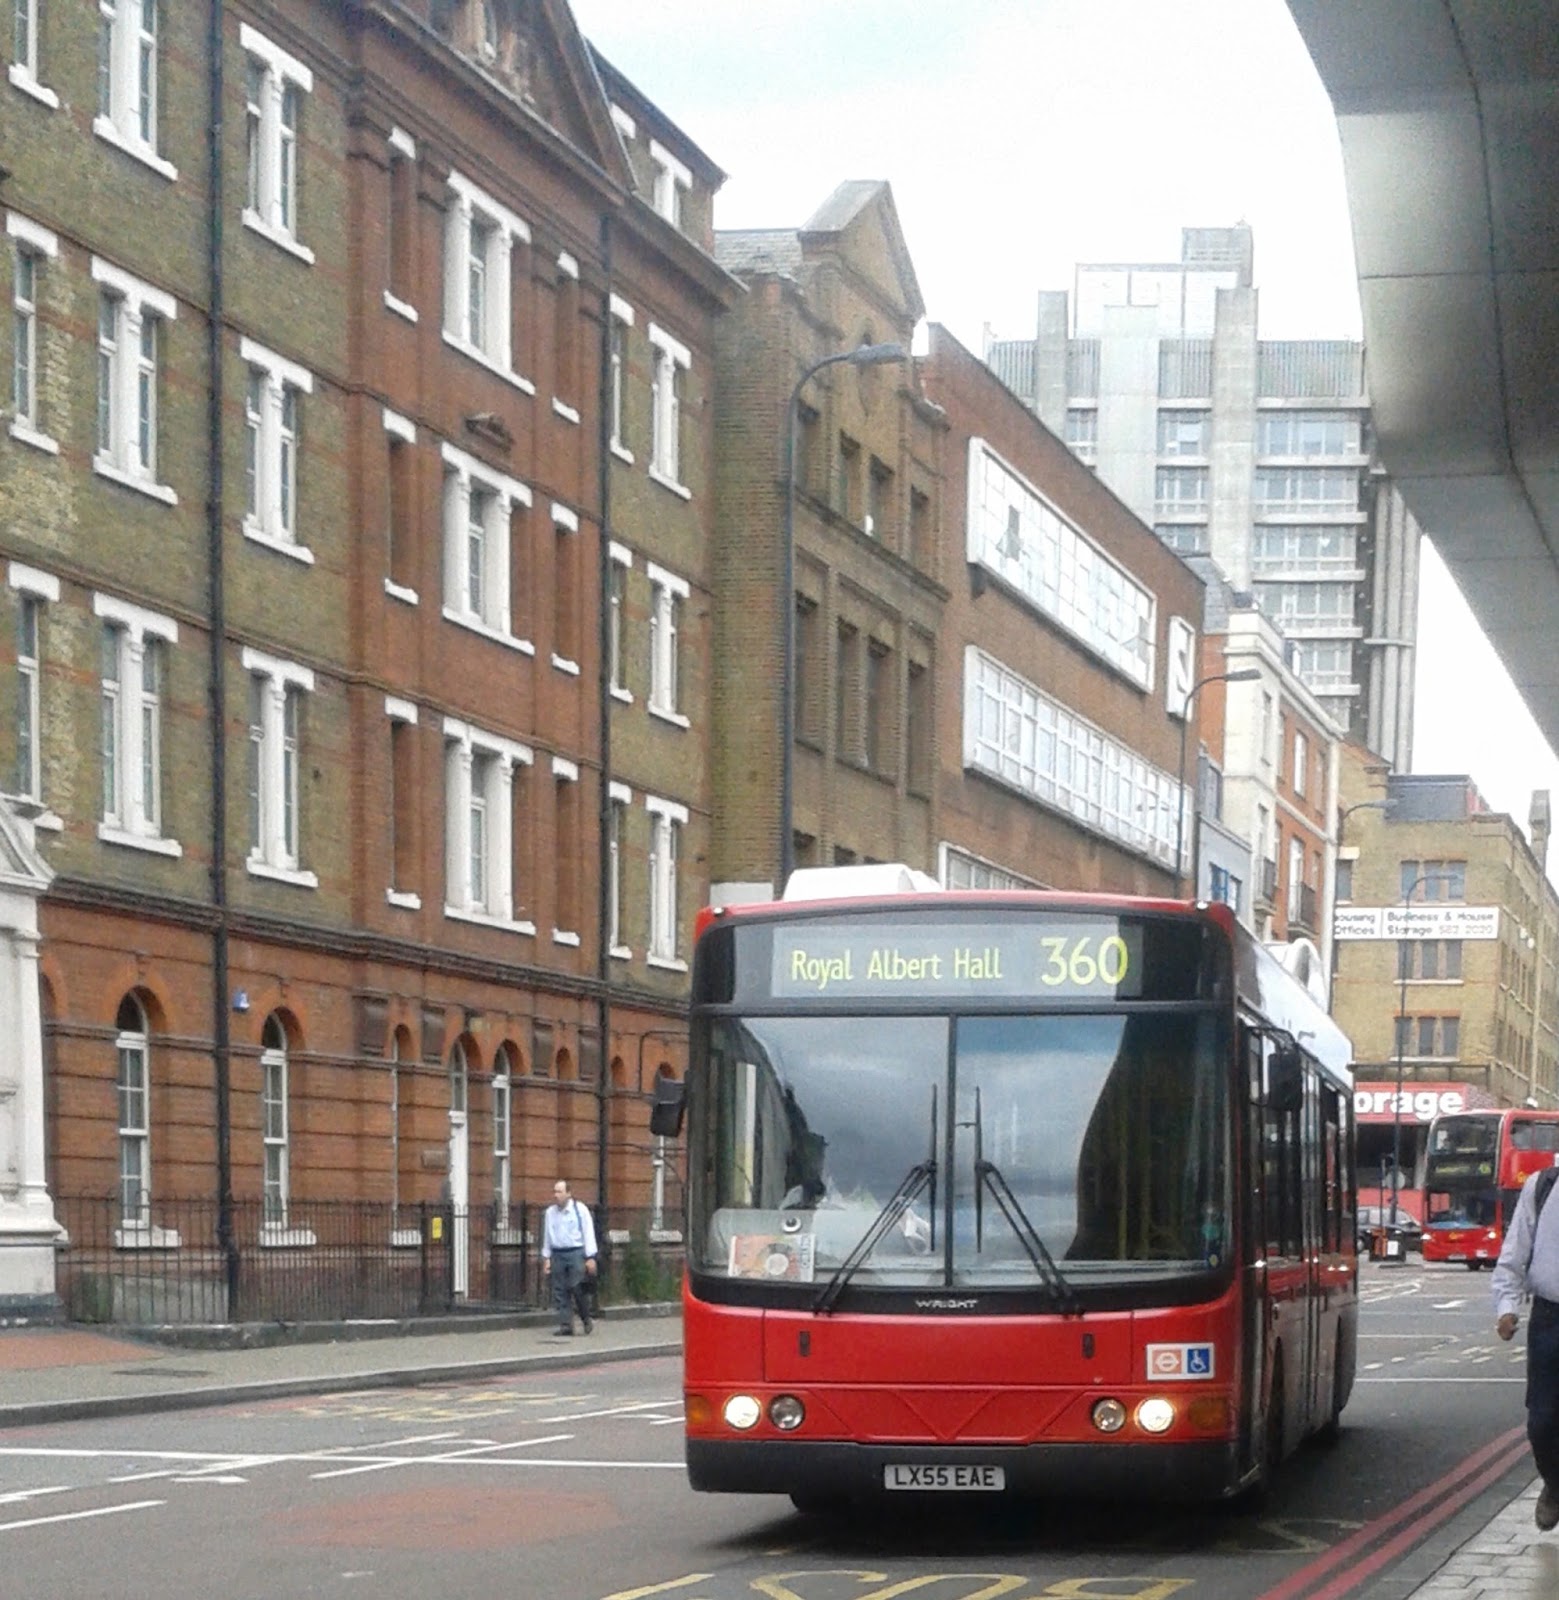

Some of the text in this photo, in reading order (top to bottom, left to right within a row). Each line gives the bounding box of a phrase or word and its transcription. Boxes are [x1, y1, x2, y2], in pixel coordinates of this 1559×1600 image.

[1387, 911, 1494, 922] Business & House
[1387, 925, 1433, 936] Storage
[791, 935, 1129, 991] Royal Albert Hall 360
[894, 1467, 995, 1487] LX55 EAE
